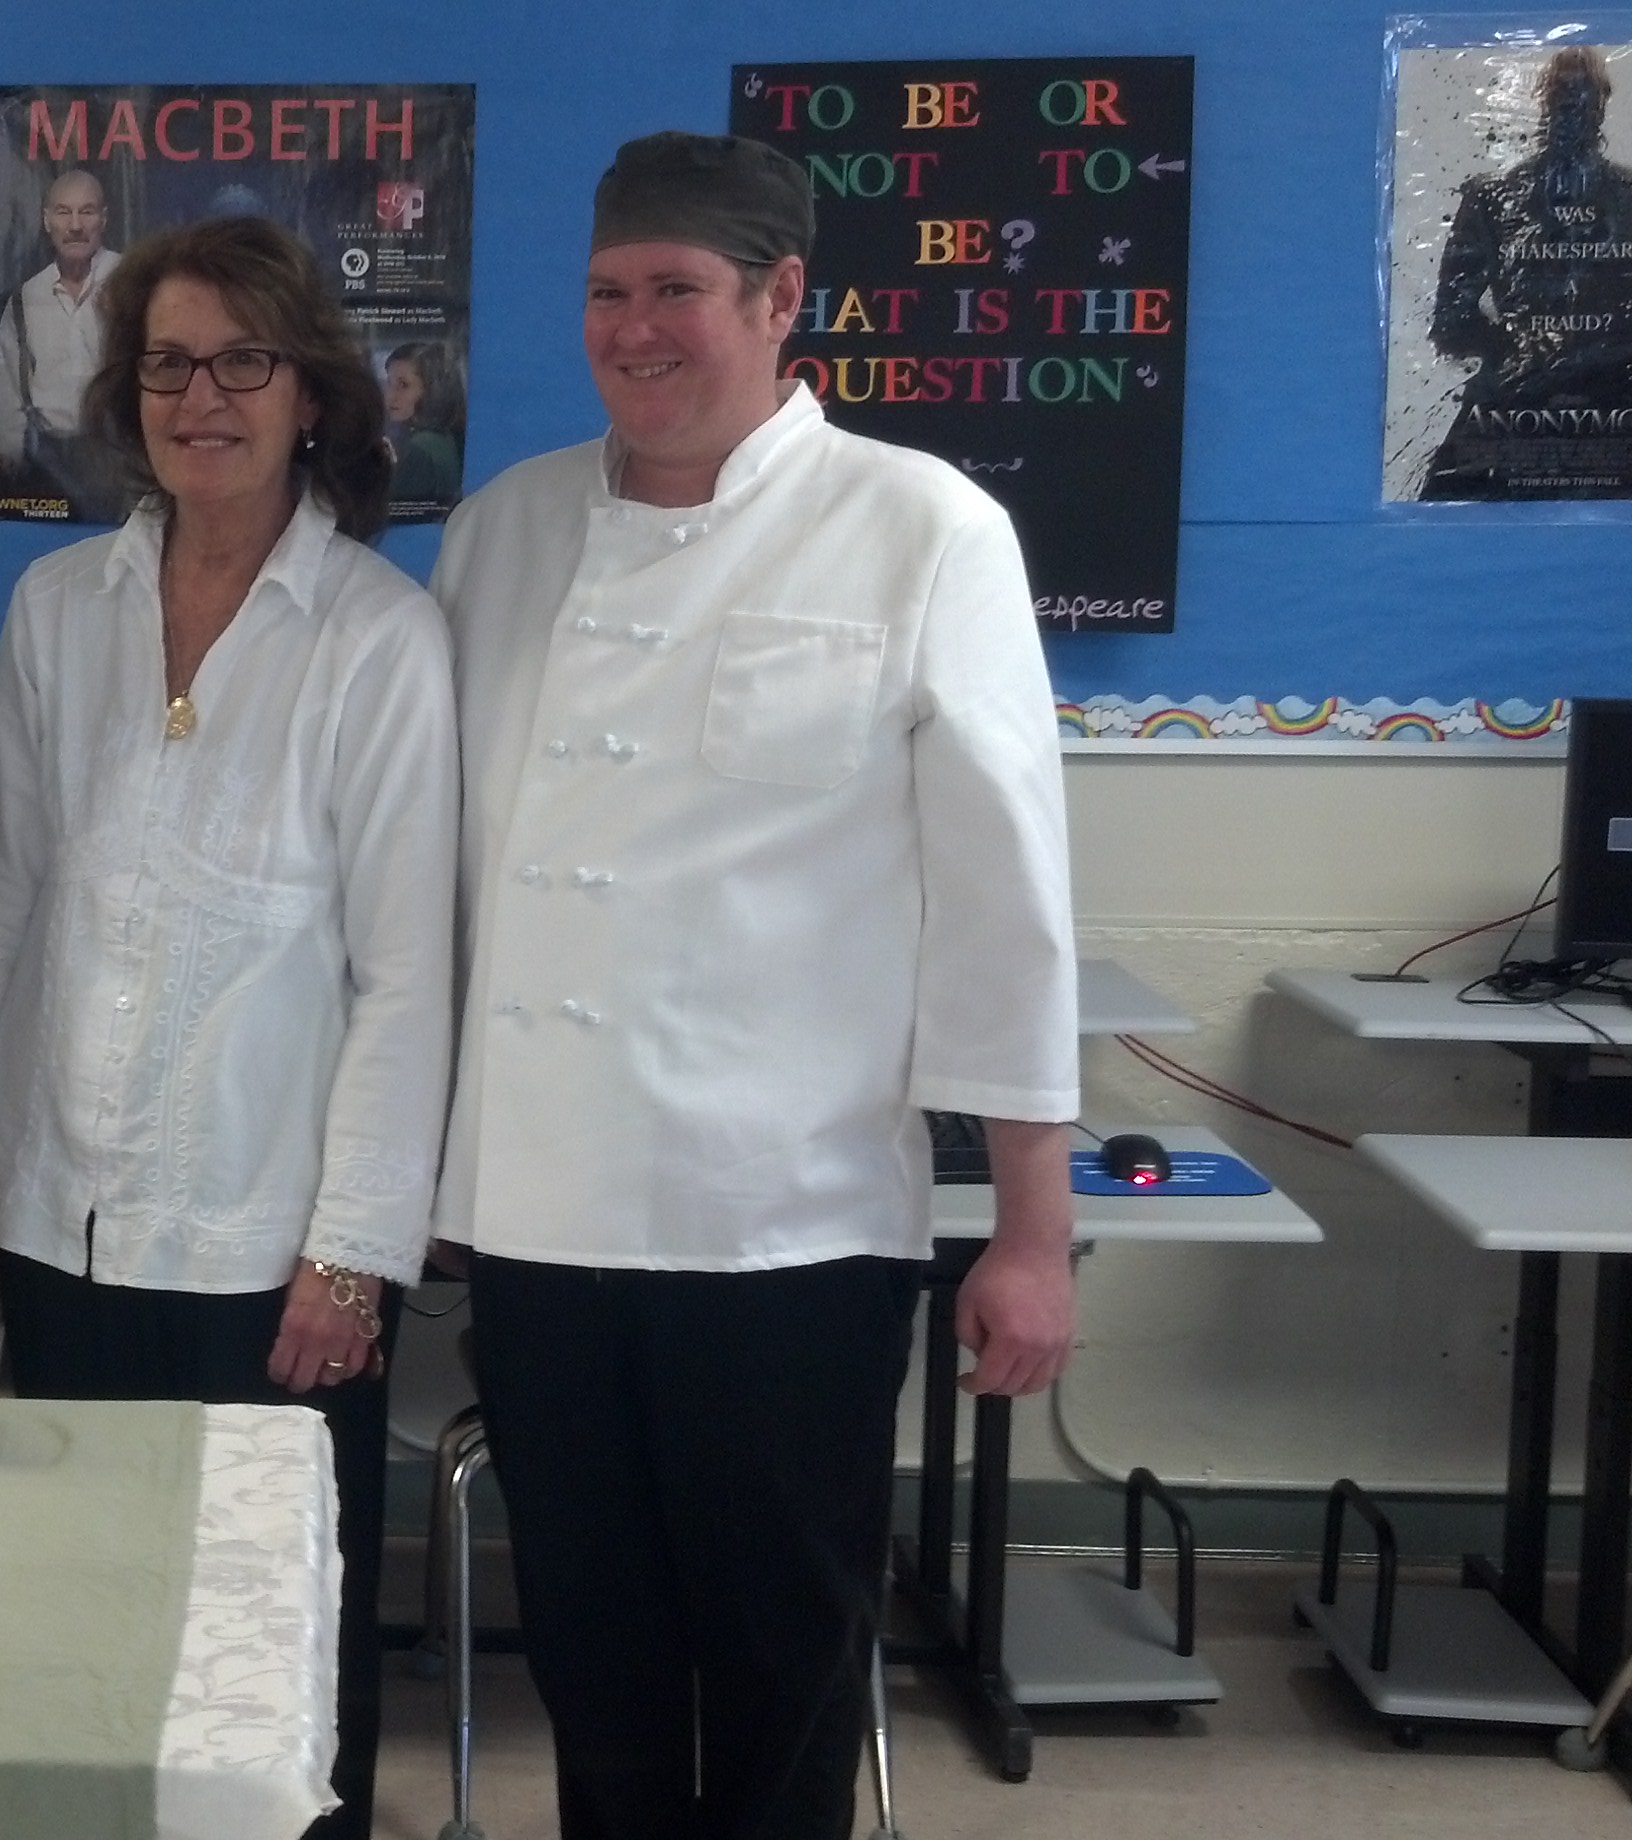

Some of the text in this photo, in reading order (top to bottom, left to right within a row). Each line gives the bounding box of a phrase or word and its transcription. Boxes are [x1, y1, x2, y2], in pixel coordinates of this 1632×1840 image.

[902, 81, 981, 129] BE
[1039, 78, 1127, 128] OR
[27, 98, 414, 162] MACBETH
[806, 147, 1132, 199] NOT TO
[1554, 205, 1596, 223] WAS
[915, 218, 1036, 275] BE?
[1497, 241, 1632, 260] SHAKESPEAR
[344, 279, 366, 290] PBS
[1564, 279, 1579, 296] A
[792, 286, 1172, 336] HAT IS THE
[1531, 313, 1613, 332] FRAUD?
[23, 510, 69, 518] THIRTEEN
